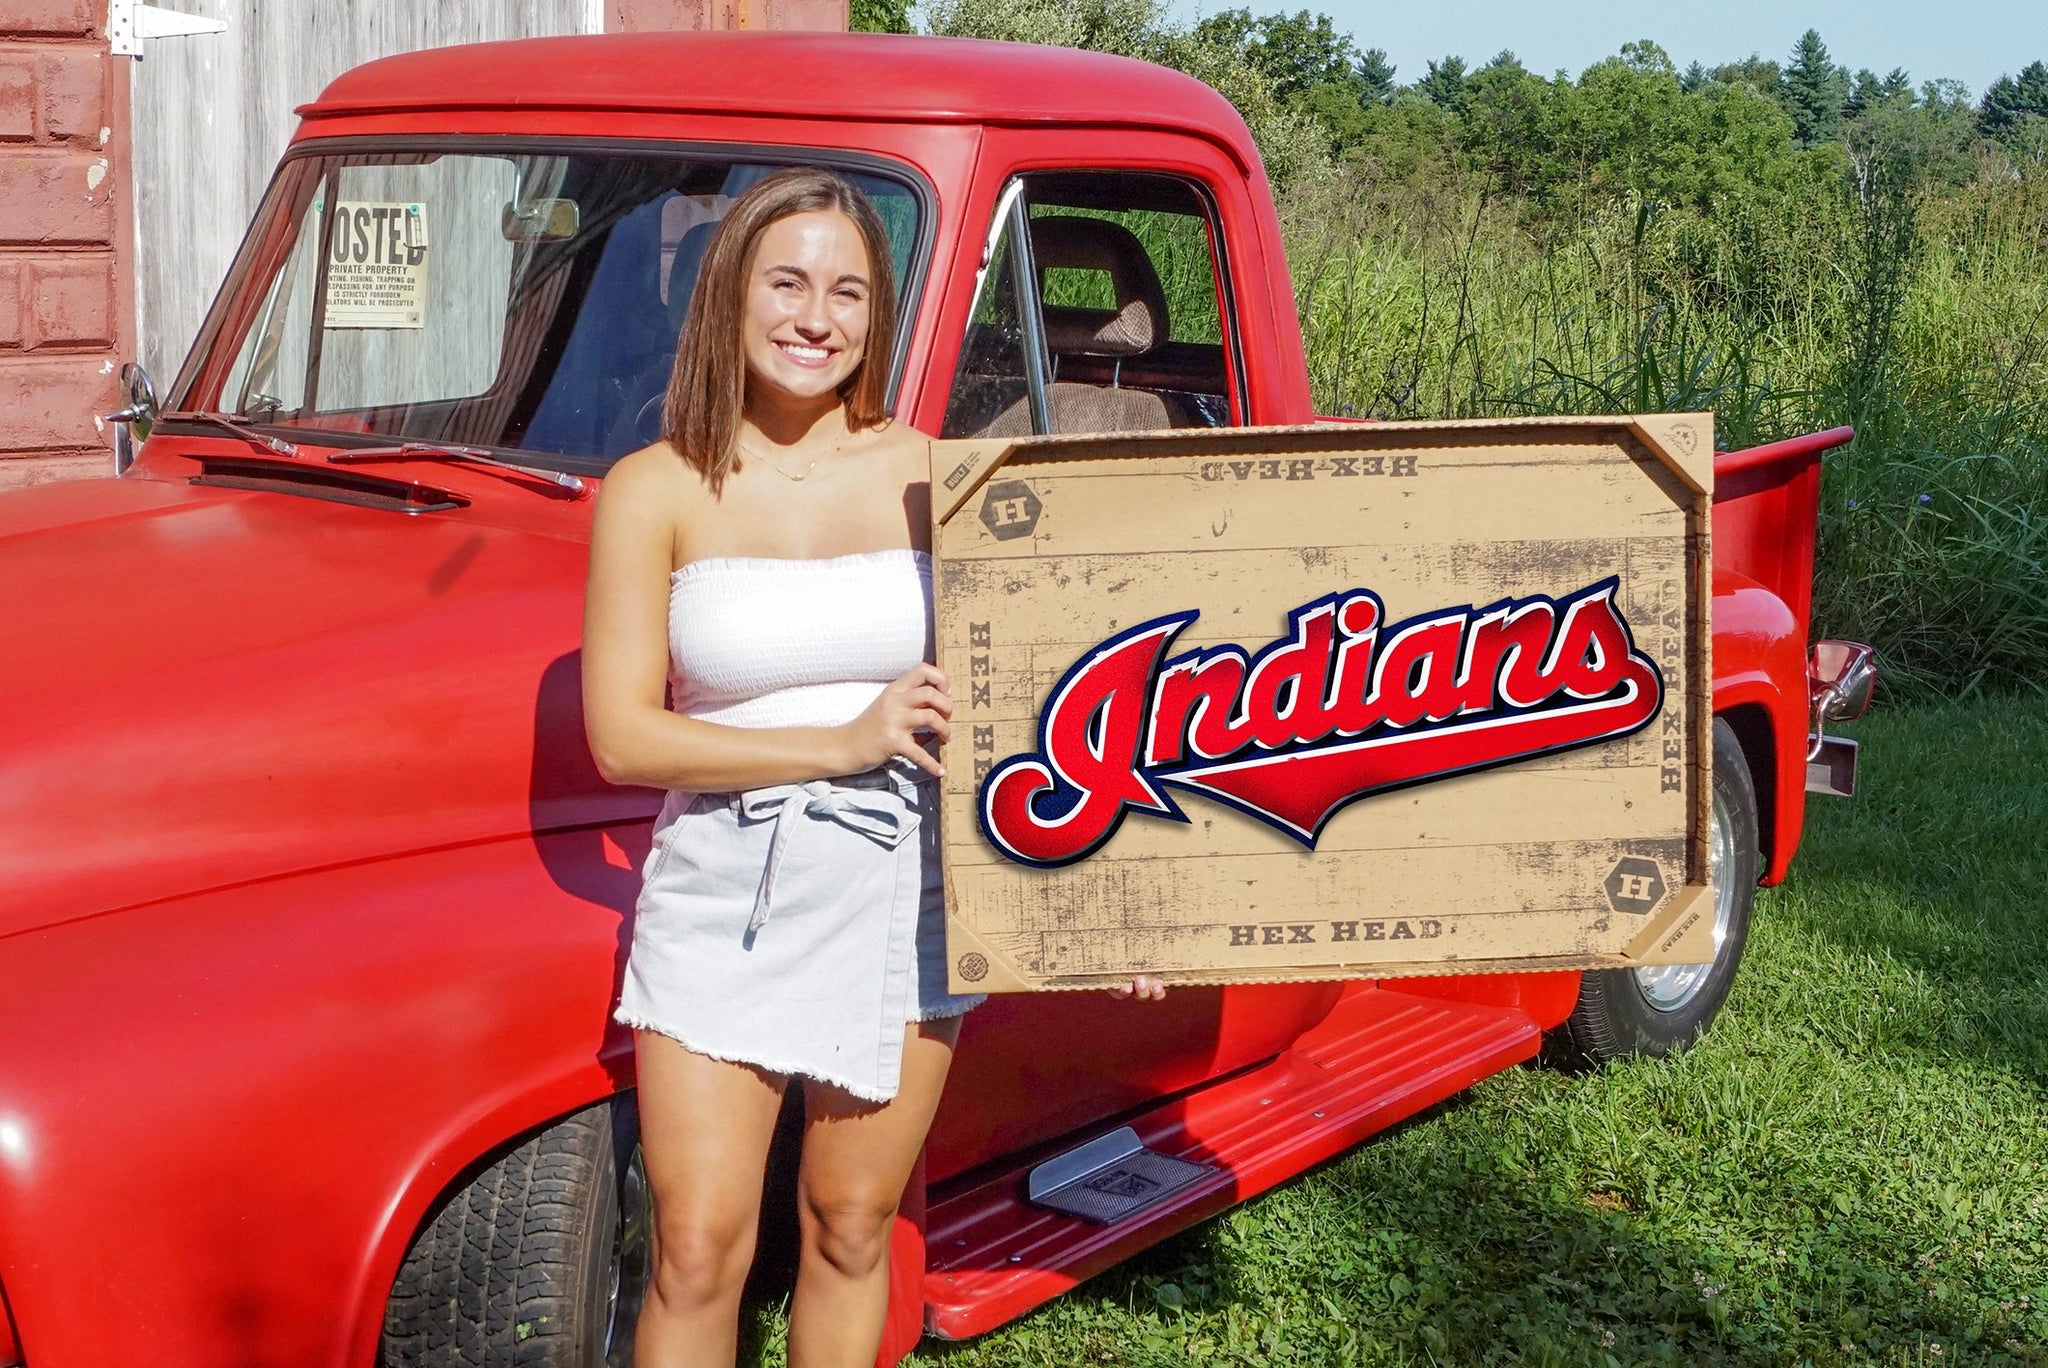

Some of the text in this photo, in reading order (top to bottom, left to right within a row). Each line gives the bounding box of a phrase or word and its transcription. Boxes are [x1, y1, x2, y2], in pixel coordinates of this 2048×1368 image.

[333, 206, 424, 266] OSTED
[329, 264, 408, 275] PRIVATE PROPERTY
[328, 282, 361, 290] ESPASSING
[375, 283, 386, 291] ANY
[369, 291, 401, 299] FORBIDDEN
[378, 299, 415, 307] PROSECUTED
[946, 465, 969, 489] BUILT
[1200, 456, 1418, 482] HEX HEAD
[992, 496, 1031, 526] H
[1661, 578, 1681, 794] HEX HEAD
[969, 621, 995, 835] HEX HE
[979, 575, 1665, 870] Indians
[1617, 873, 1654, 901] H
[1228, 919, 1443, 947] HEX HEAD
